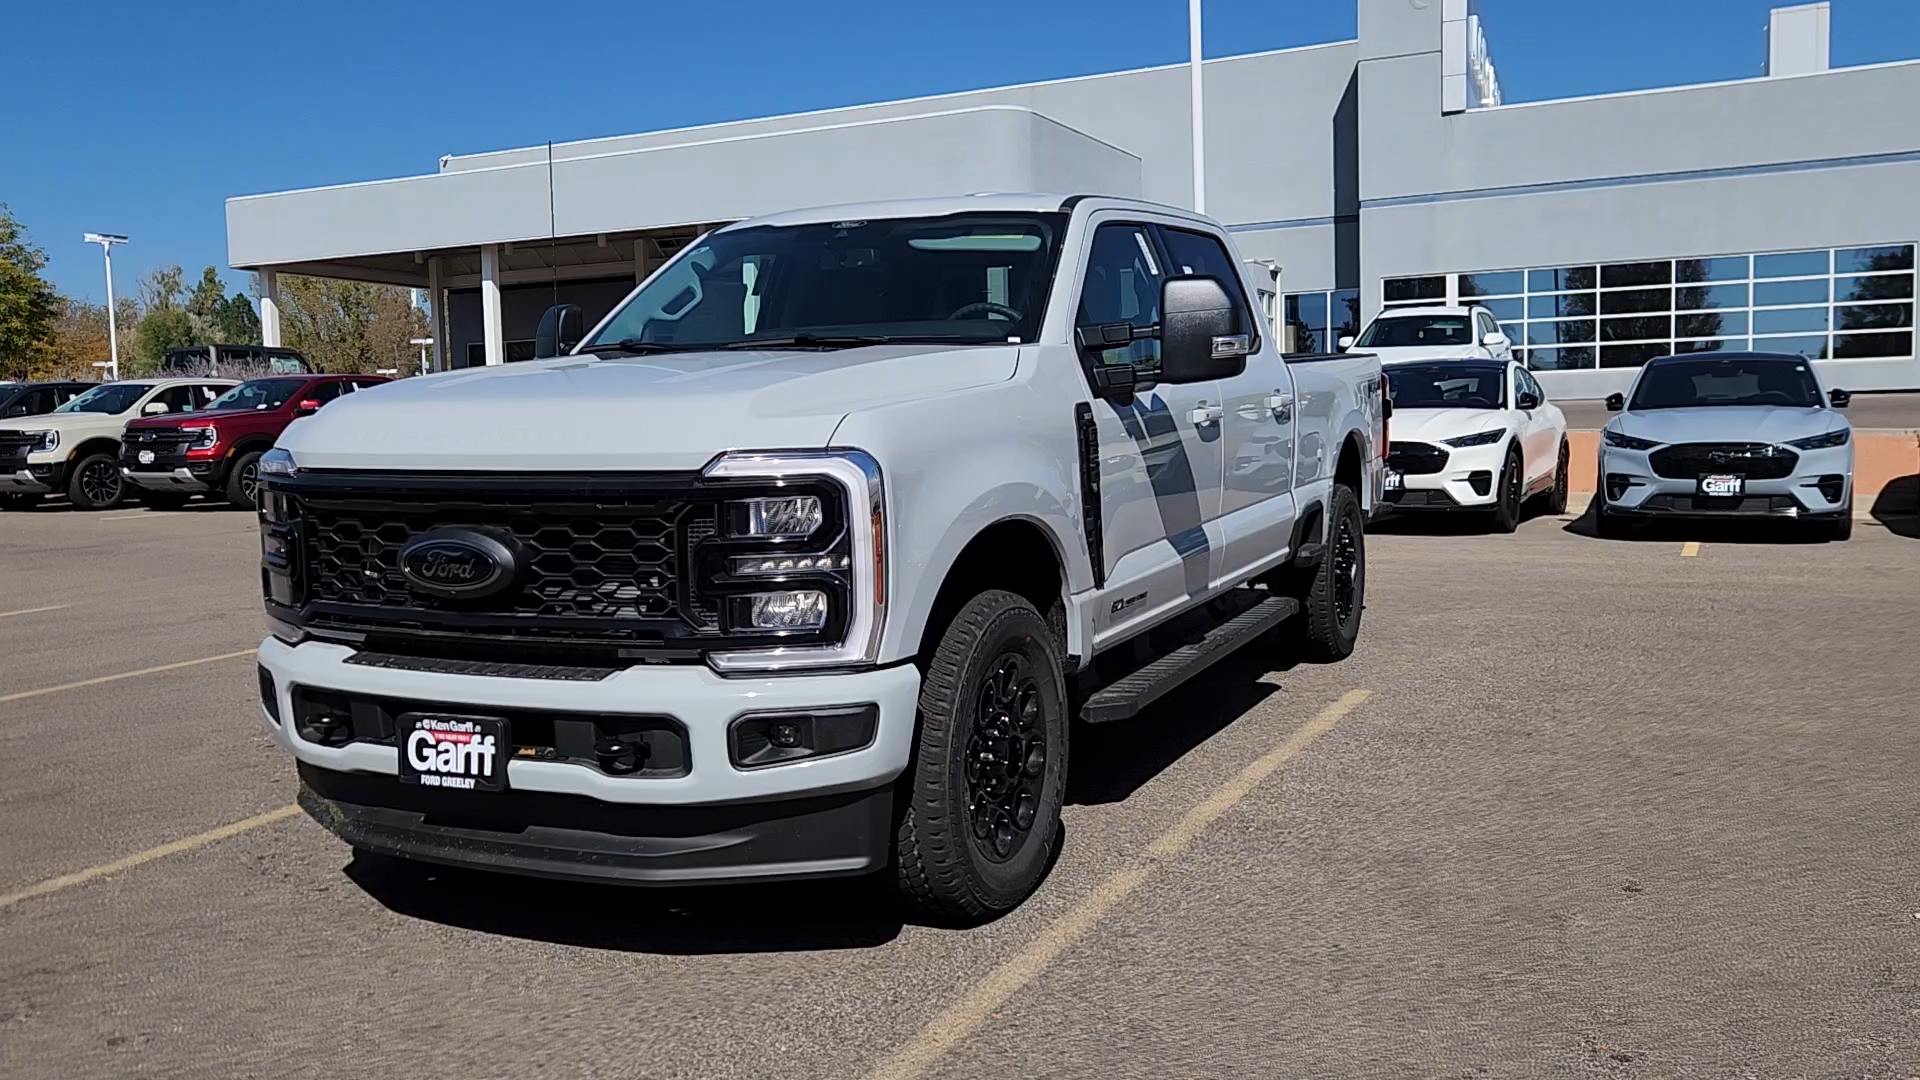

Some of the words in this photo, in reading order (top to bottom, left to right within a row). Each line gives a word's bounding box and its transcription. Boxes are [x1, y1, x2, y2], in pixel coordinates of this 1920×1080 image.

[1702, 478, 1742, 493] Garff
[421, 549, 476, 579] Ford
[430, 719, 450, 731] Ken
[450, 720, 473, 733] Garff
[407, 729, 496, 777] Garff
[420, 774, 441, 786] FORD
[441, 775, 476, 790] GREELEY
